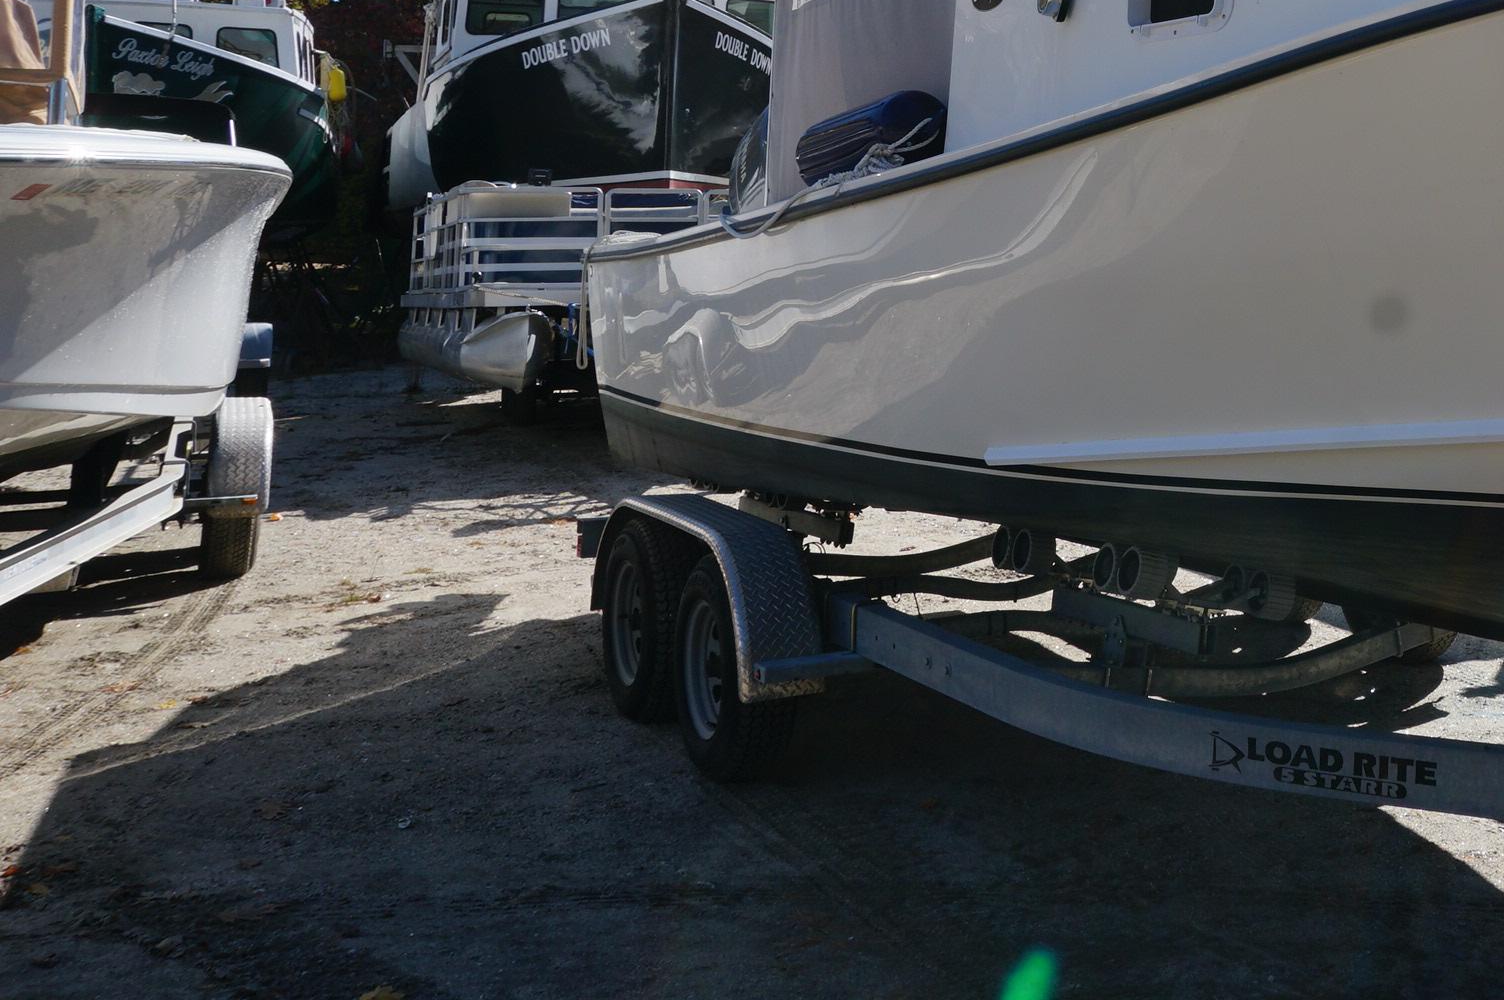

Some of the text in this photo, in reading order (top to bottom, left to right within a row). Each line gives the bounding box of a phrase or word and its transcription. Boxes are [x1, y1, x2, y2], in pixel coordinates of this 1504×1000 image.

[521, 28, 611, 70] DOUBLE DOWN
[714, 31, 750, 62] DOUBLE
[1247, 736, 1438, 787] LOAD RITE
[1280, 766, 1402, 799] 5 STARR
